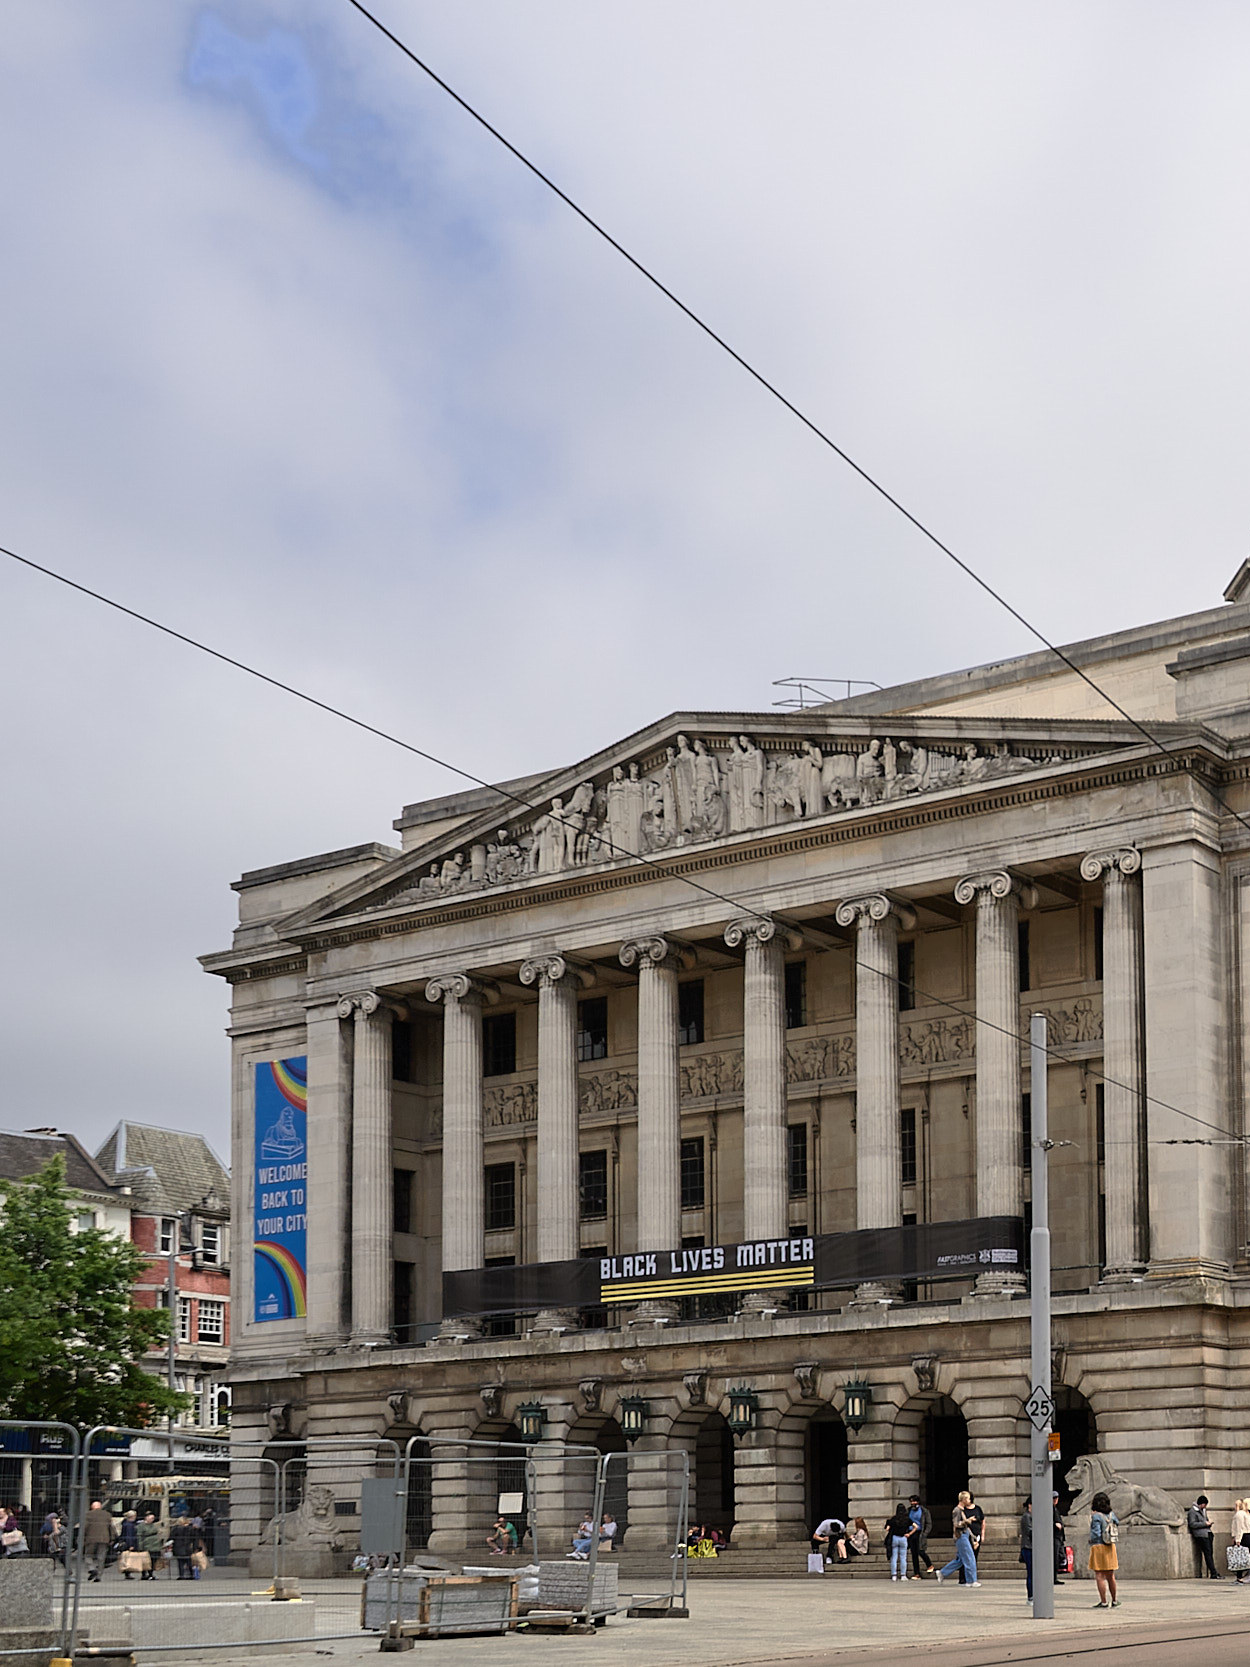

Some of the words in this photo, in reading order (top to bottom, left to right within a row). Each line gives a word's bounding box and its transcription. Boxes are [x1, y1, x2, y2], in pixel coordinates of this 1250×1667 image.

[259, 1163, 307, 1185] WELCOME
[261, 1191, 288, 1209] BACK
[291, 1188, 304, 1205] TO
[257, 1215, 284, 1235] YOUR
[286, 1213, 308, 1232] CITY
[600, 1254, 657, 1280] BLACK
[670, 1248, 725, 1273] LIVES
[736, 1238, 814, 1268] MATTER
[1030, 1400, 1049, 1416] 25
